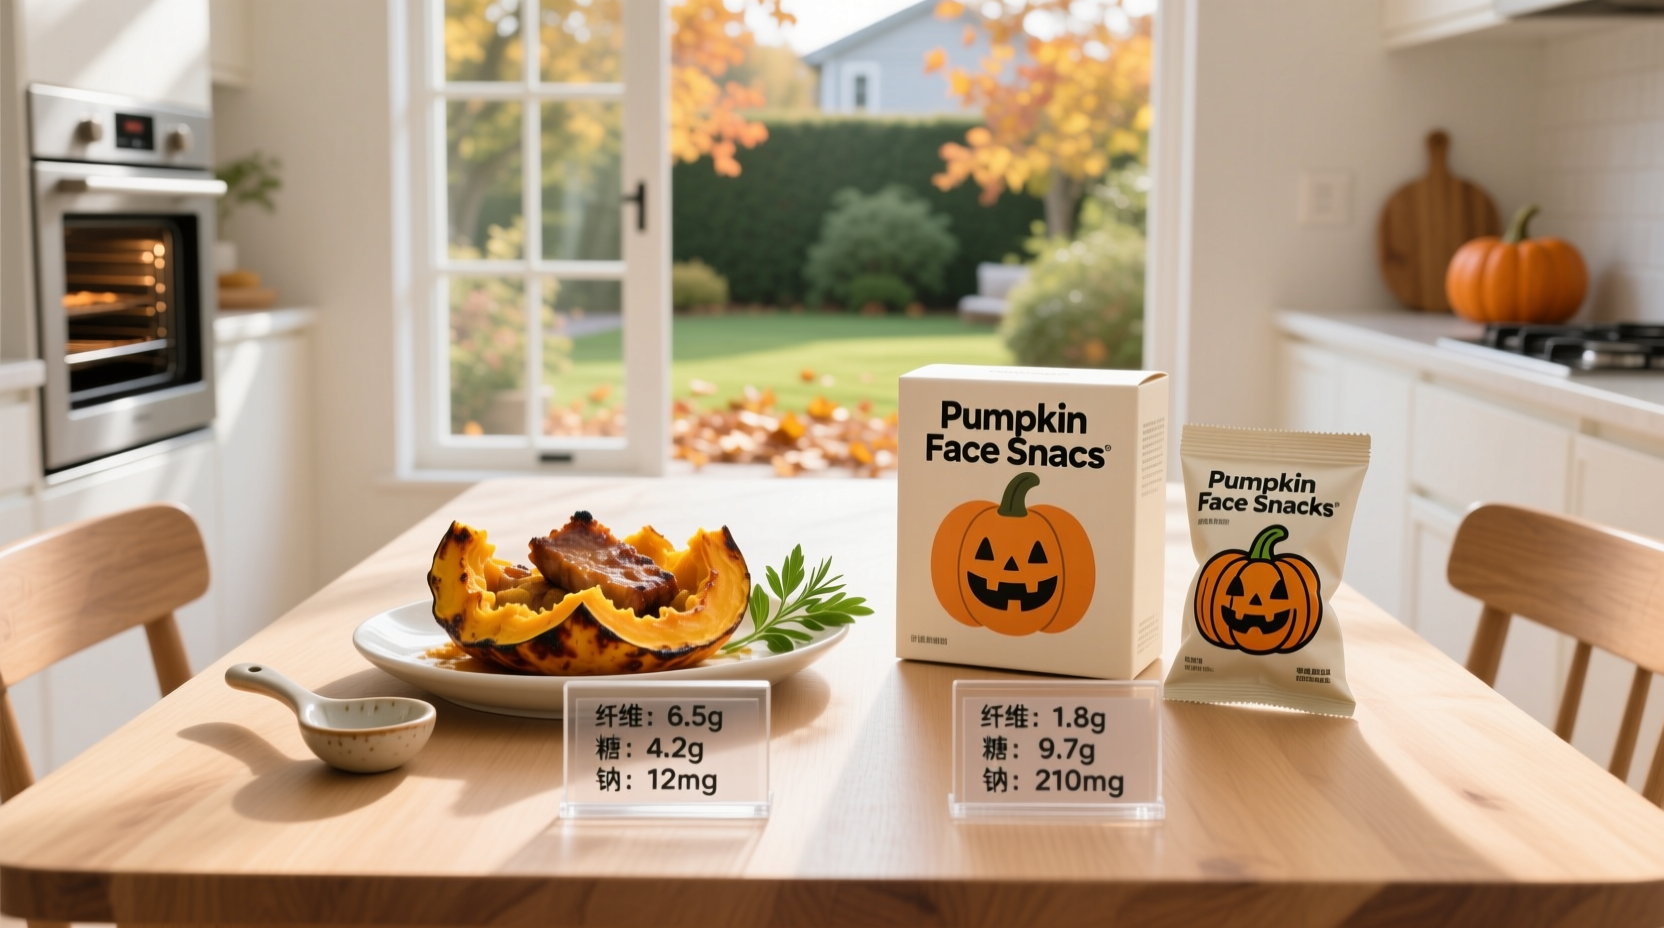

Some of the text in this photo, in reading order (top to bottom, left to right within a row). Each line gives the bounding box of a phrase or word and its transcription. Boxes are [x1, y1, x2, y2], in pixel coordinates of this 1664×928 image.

[941, 400, 1088, 437] Pumpkin
[926, 433, 1000, 463] Face
[1208, 470, 1317, 494] Pumpkin
[1198, 492, 1248, 512] Face
[667, 705, 723, 732] 6.5g
[1053, 706, 1106, 734] 1.8g
[646, 736, 704, 764] 4.2g
[1038, 737, 1095, 765] 9.7g
[647, 768, 717, 796] 12mg
[1035, 769, 1124, 798] 210mg
